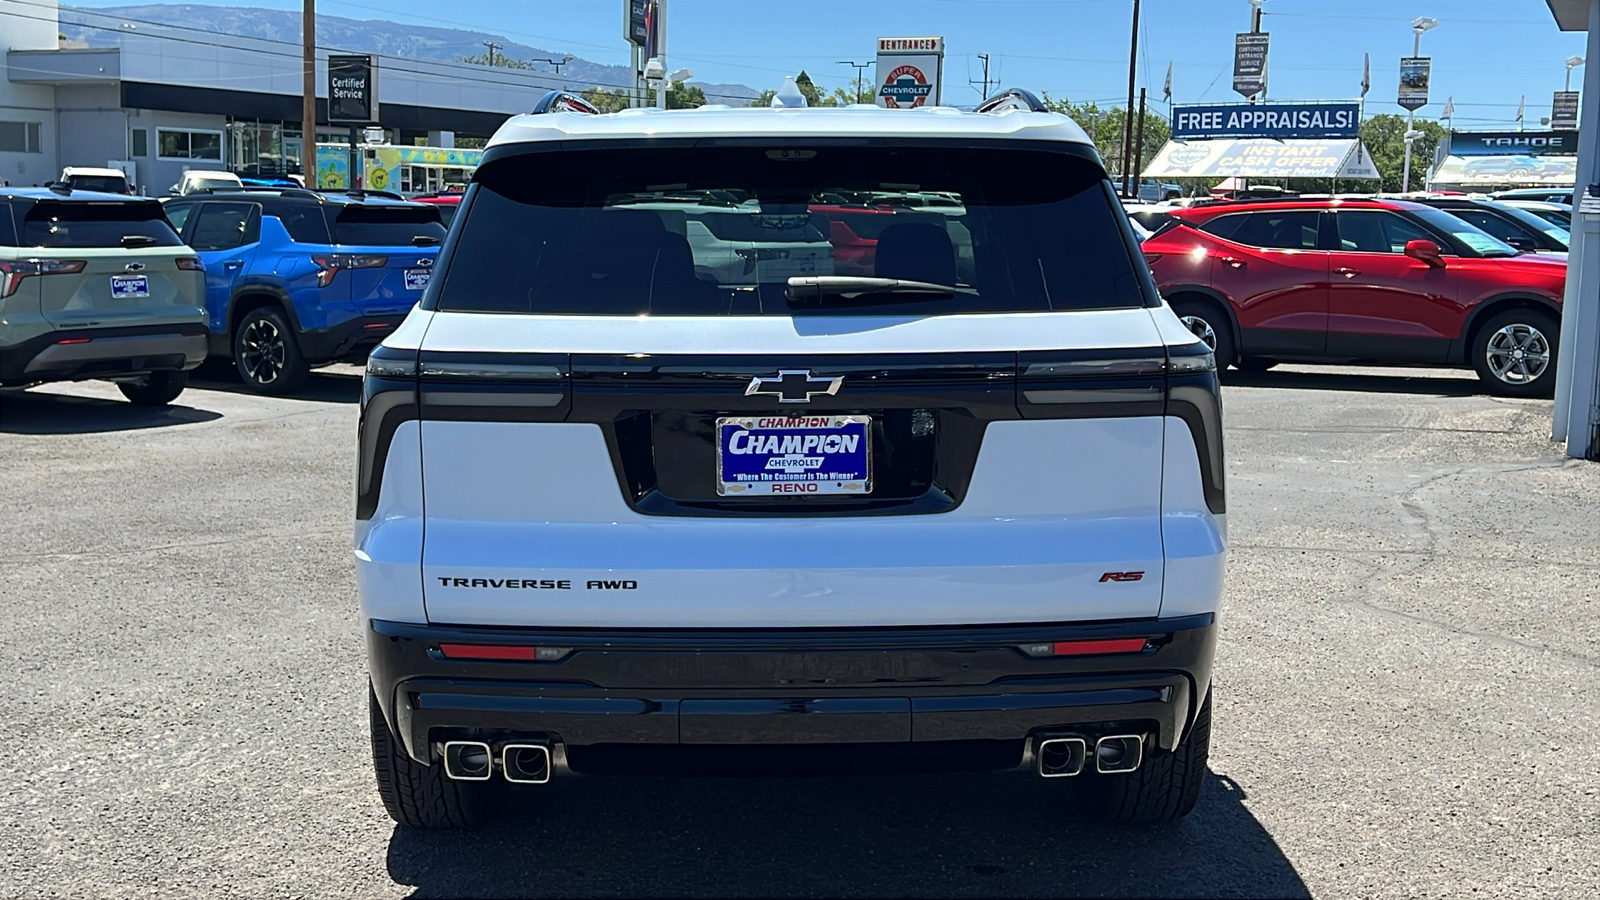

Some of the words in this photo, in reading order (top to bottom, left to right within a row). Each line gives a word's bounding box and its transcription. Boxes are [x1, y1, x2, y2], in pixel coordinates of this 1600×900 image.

[886, 40, 930, 50] ENTRANCE
[891, 67, 922, 79] SUPER
[332, 77, 365, 88] Certified
[333, 88, 363, 98] Service
[1178, 112, 1223, 130] FREE
[1227, 110, 1353, 129] APPRAISALS!
[1481, 137, 1563, 147] TAHOE
[1243, 146, 1328, 156] INSTANT
[1219, 156, 1272, 166] CASH
[1275, 157, 1338, 167] OFFER
[114, 279, 145, 287] CHAMPION
[758, 417, 830, 429] CHAMPION
[728, 430, 860, 455] CHAMPION
[769, 459, 820, 467] CHEVROLET
[760, 473, 773, 481] The
[774, 473, 807, 481] Customer
[771, 483, 818, 493] RENO
[1098, 571, 1146, 582] RS
[438, 577, 571, 590] TRAVERSE
[586, 580, 638, 590] AWD
